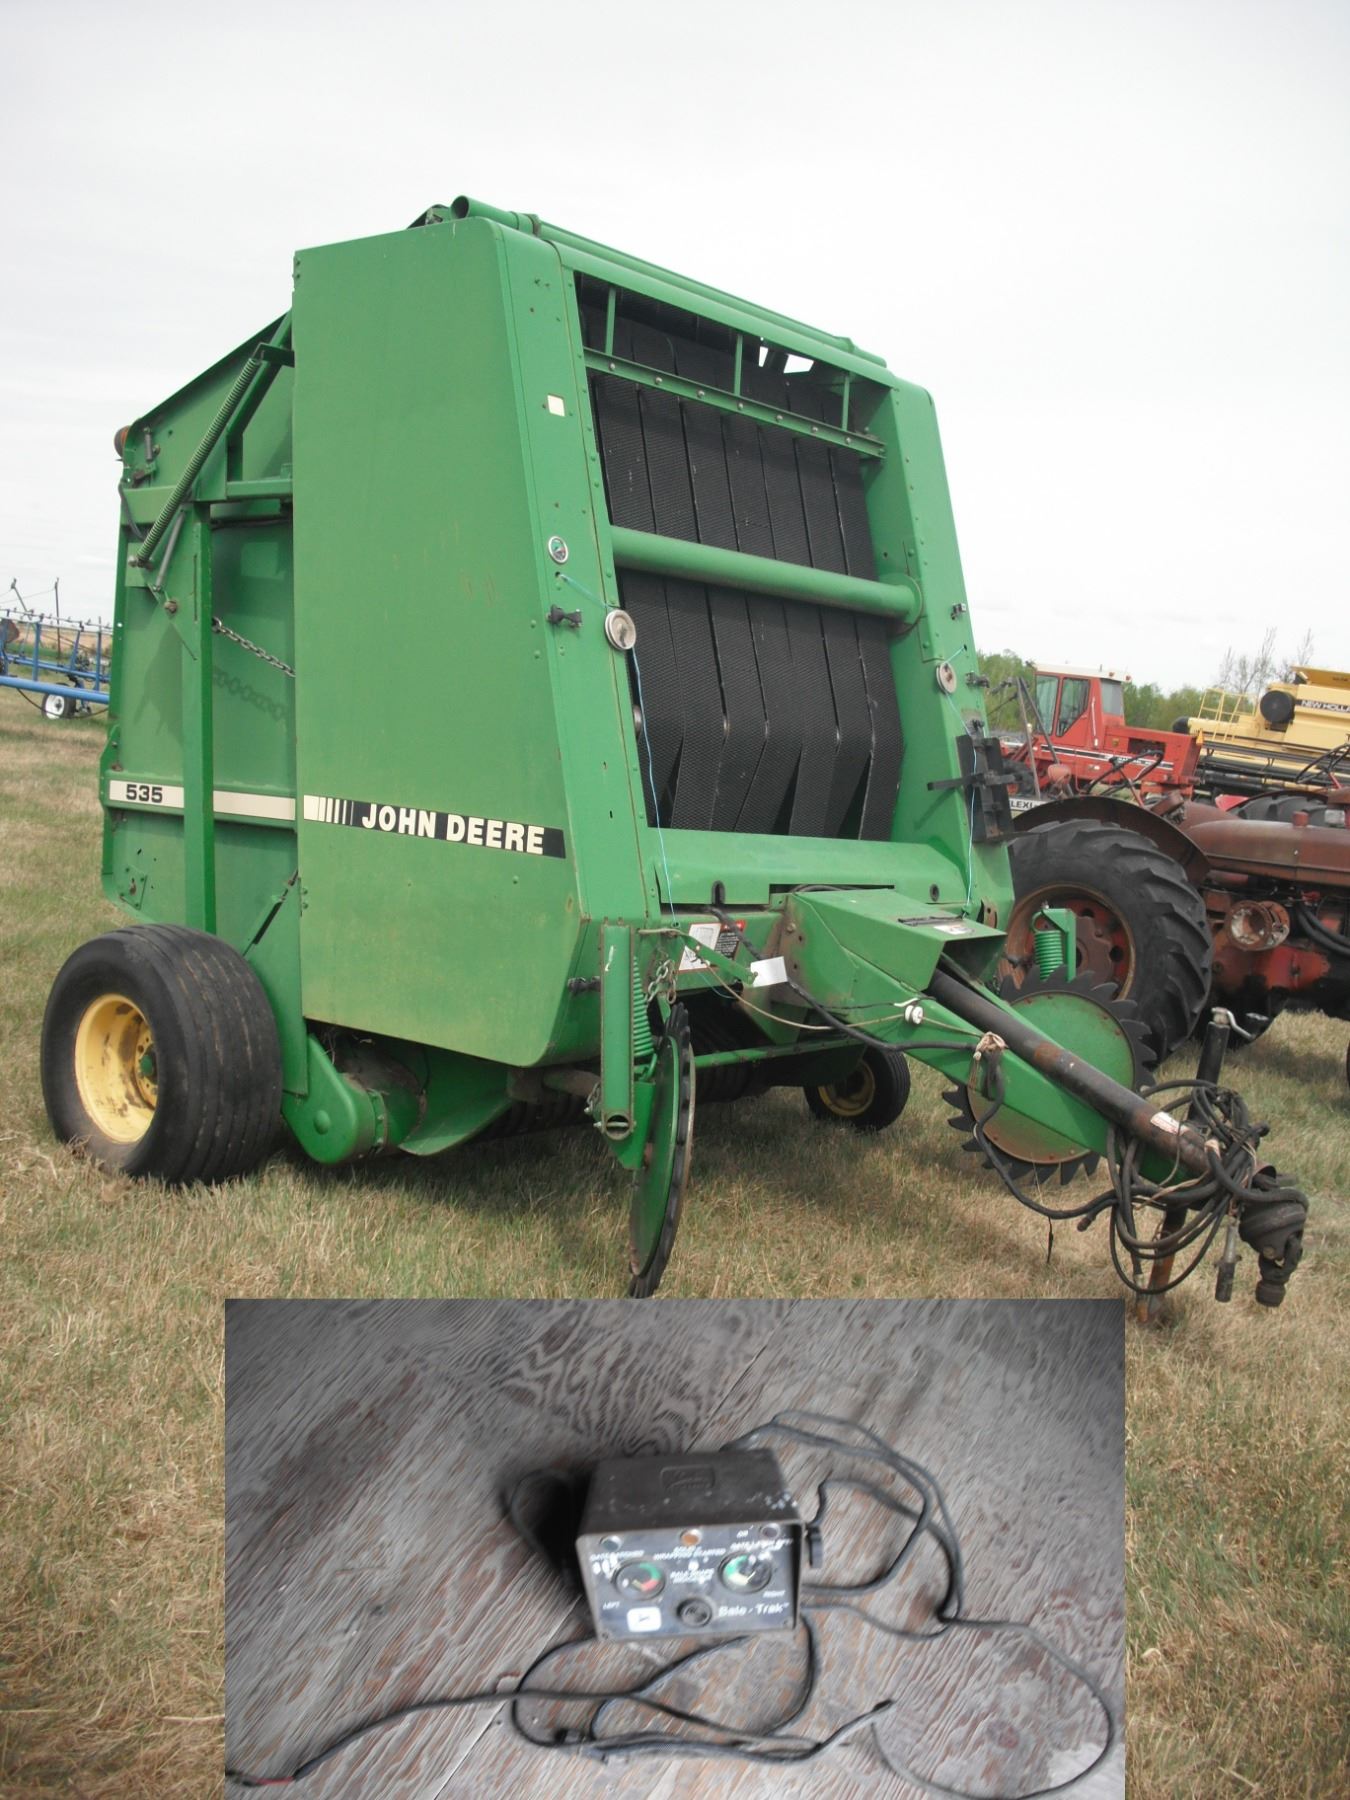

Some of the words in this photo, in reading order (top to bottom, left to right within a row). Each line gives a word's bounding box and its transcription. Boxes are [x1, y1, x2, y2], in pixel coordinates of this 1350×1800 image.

[1301, 699, 1322, 709] NEW
[126, 783, 163, 803] 535
[362, 803, 437, 838] JOHN
[446, 813, 545, 855] DEERE
